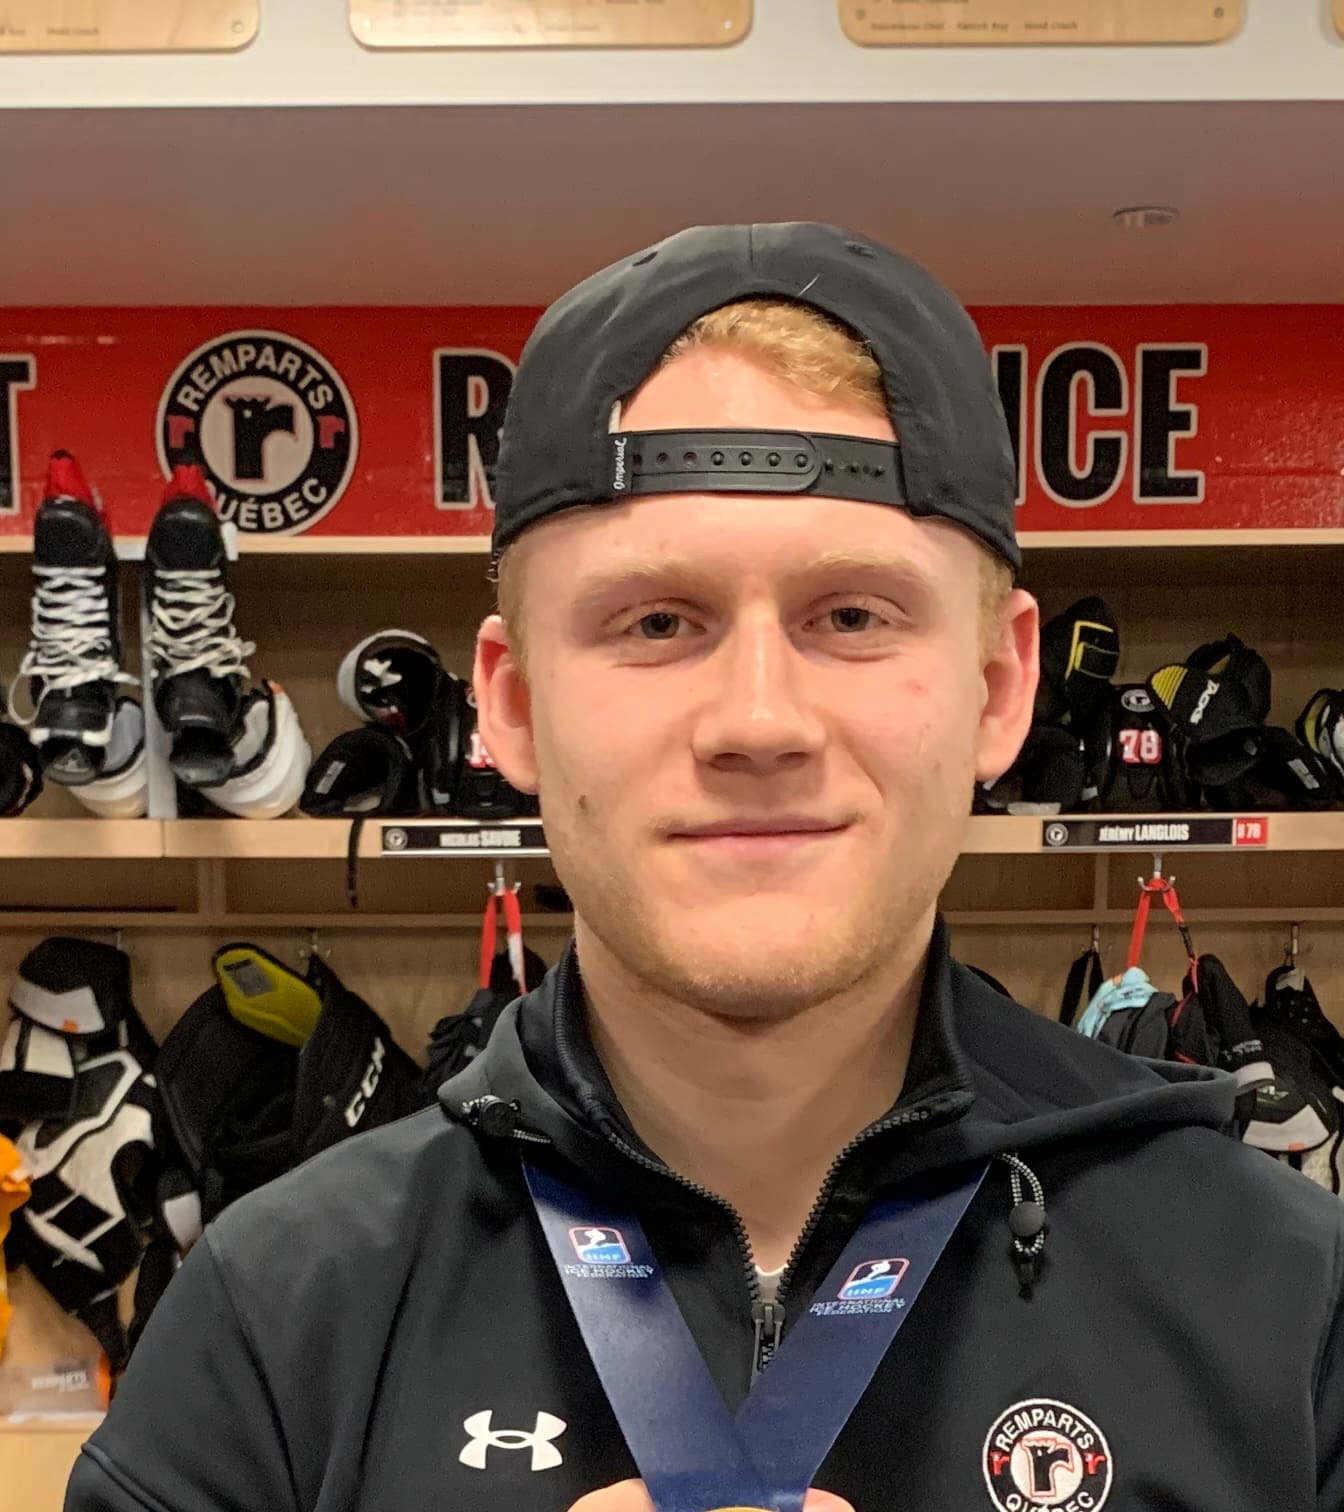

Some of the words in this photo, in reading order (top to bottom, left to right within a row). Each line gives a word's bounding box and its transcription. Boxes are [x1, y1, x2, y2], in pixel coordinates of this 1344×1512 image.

[175, 343, 334, 411] REMPARTS
[205, 477, 327, 529] UÉBEC
[1119, 728, 1163, 765] 78
[1134, 823, 1190, 841] LANGLOIS
[995, 1408, 1095, 1452] REMPARTS
